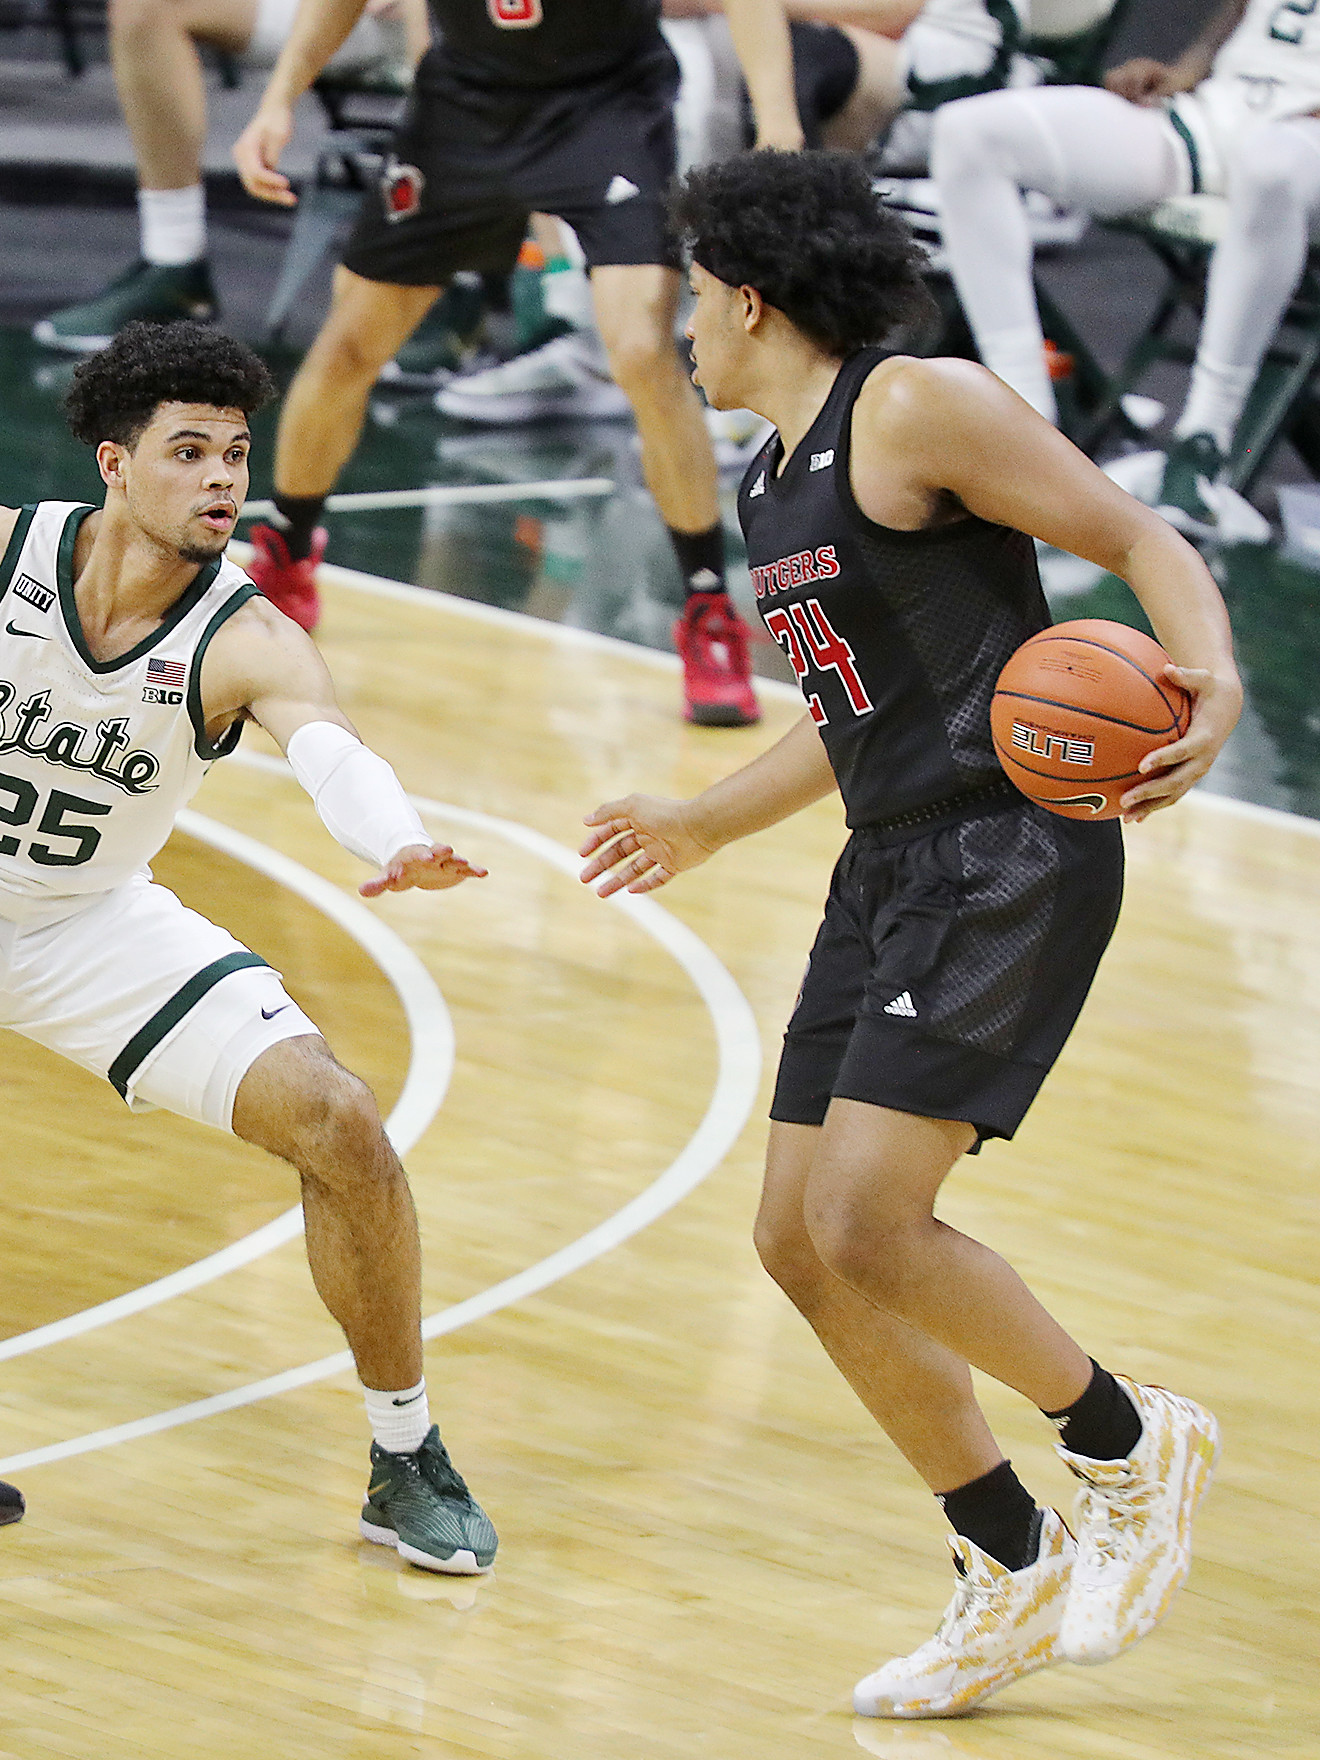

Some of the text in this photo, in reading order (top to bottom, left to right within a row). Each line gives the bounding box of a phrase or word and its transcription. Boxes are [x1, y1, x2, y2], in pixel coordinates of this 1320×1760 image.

[15, 577, 55, 610] UNITY
[749, 545, 840, 600] UTGERS
[764, 598, 874, 727] 24
[1012, 722, 1095, 767] ELITE
